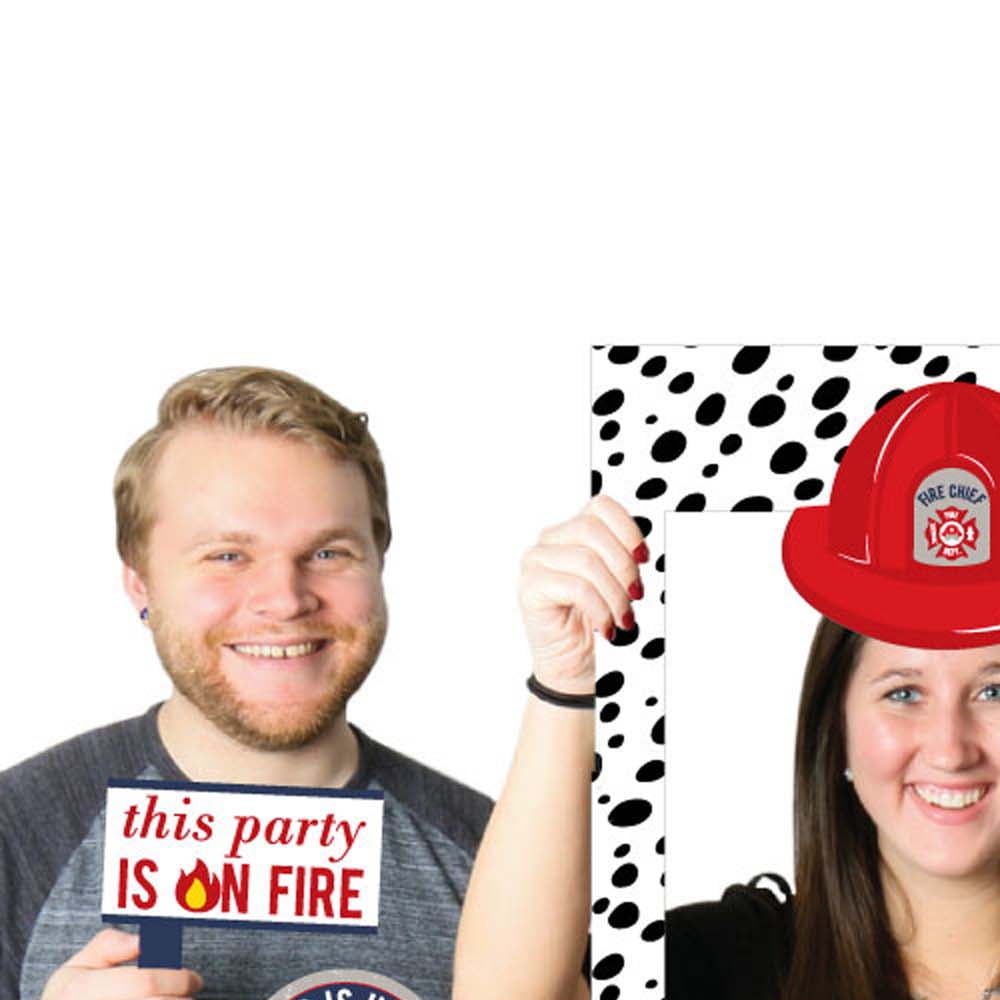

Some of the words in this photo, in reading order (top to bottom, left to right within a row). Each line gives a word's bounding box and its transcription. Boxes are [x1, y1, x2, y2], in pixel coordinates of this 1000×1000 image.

[917, 485, 945, 507] FIRE
[949, 483, 987, 504] CHIEF
[122, 794, 215, 842] this
[224, 813, 367, 863] party
[117, 858, 159, 910] IS
[269, 865, 364, 918] FIRE
